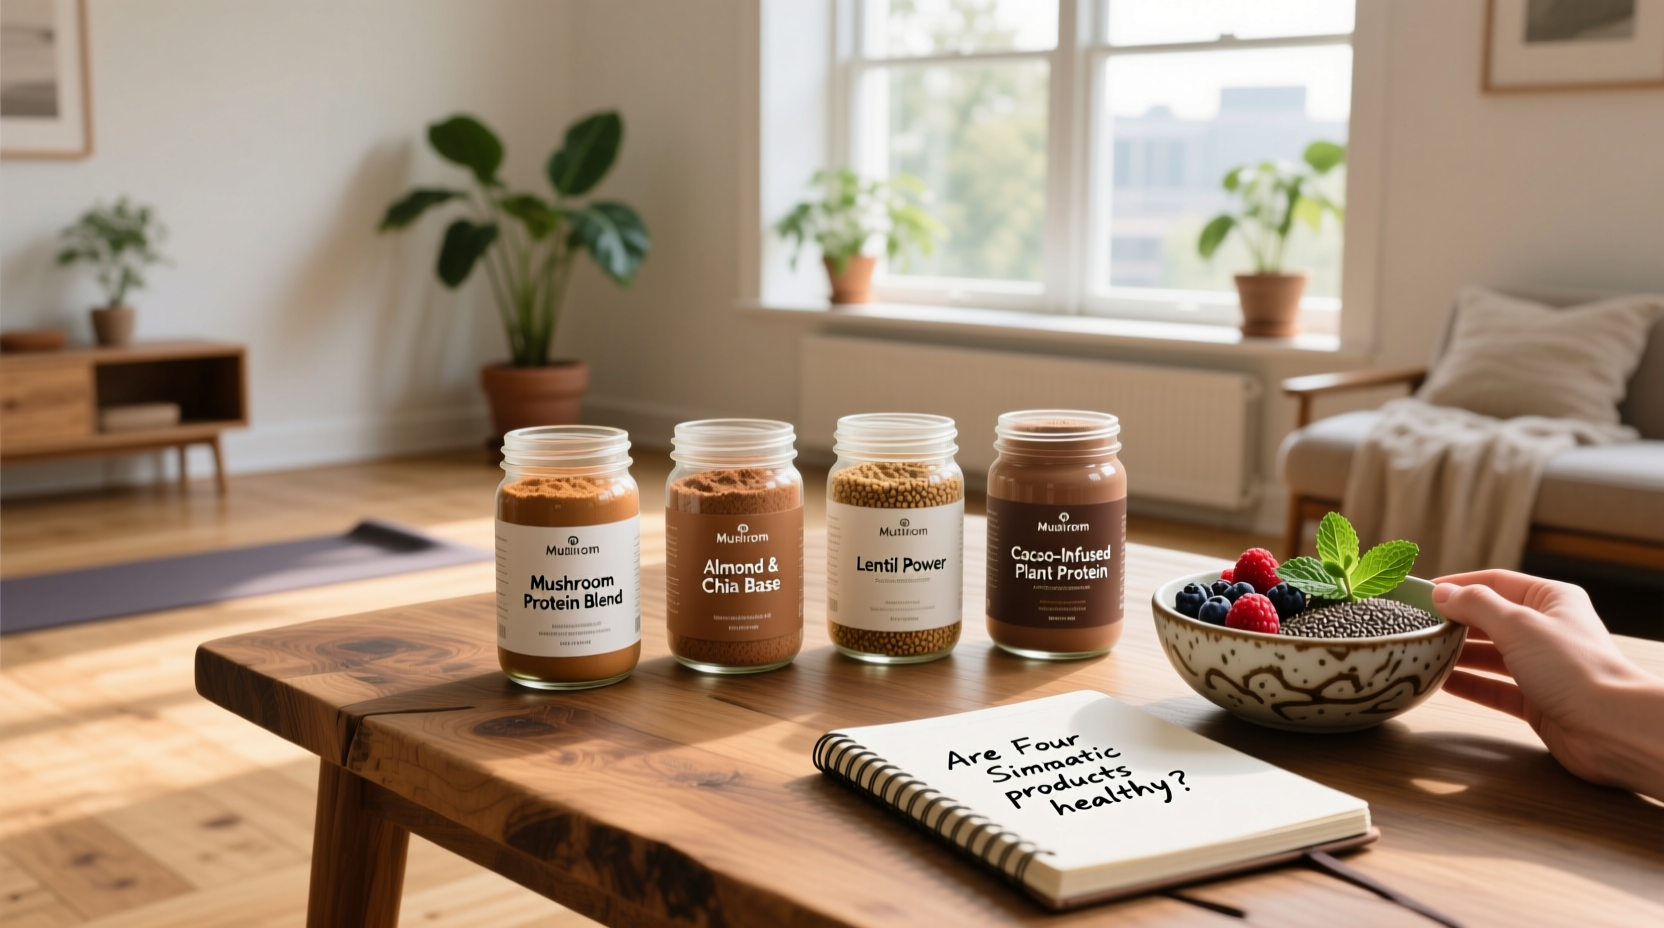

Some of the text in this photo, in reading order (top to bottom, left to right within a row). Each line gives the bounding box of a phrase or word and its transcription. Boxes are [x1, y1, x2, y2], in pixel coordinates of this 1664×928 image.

[703, 556, 779, 575] Almond &
[857, 556, 947, 573] Lentil Power
[1015, 563, 1108, 580] Plant Protein
[530, 574, 614, 591] Mushroom
[702, 577, 781, 594] Chia Base
[523, 588, 623, 611] Protein Blend
[947, 734, 1080, 770] Are Four
[1004, 765, 1132, 809] products
[1049, 769, 1191, 816] healthy?
